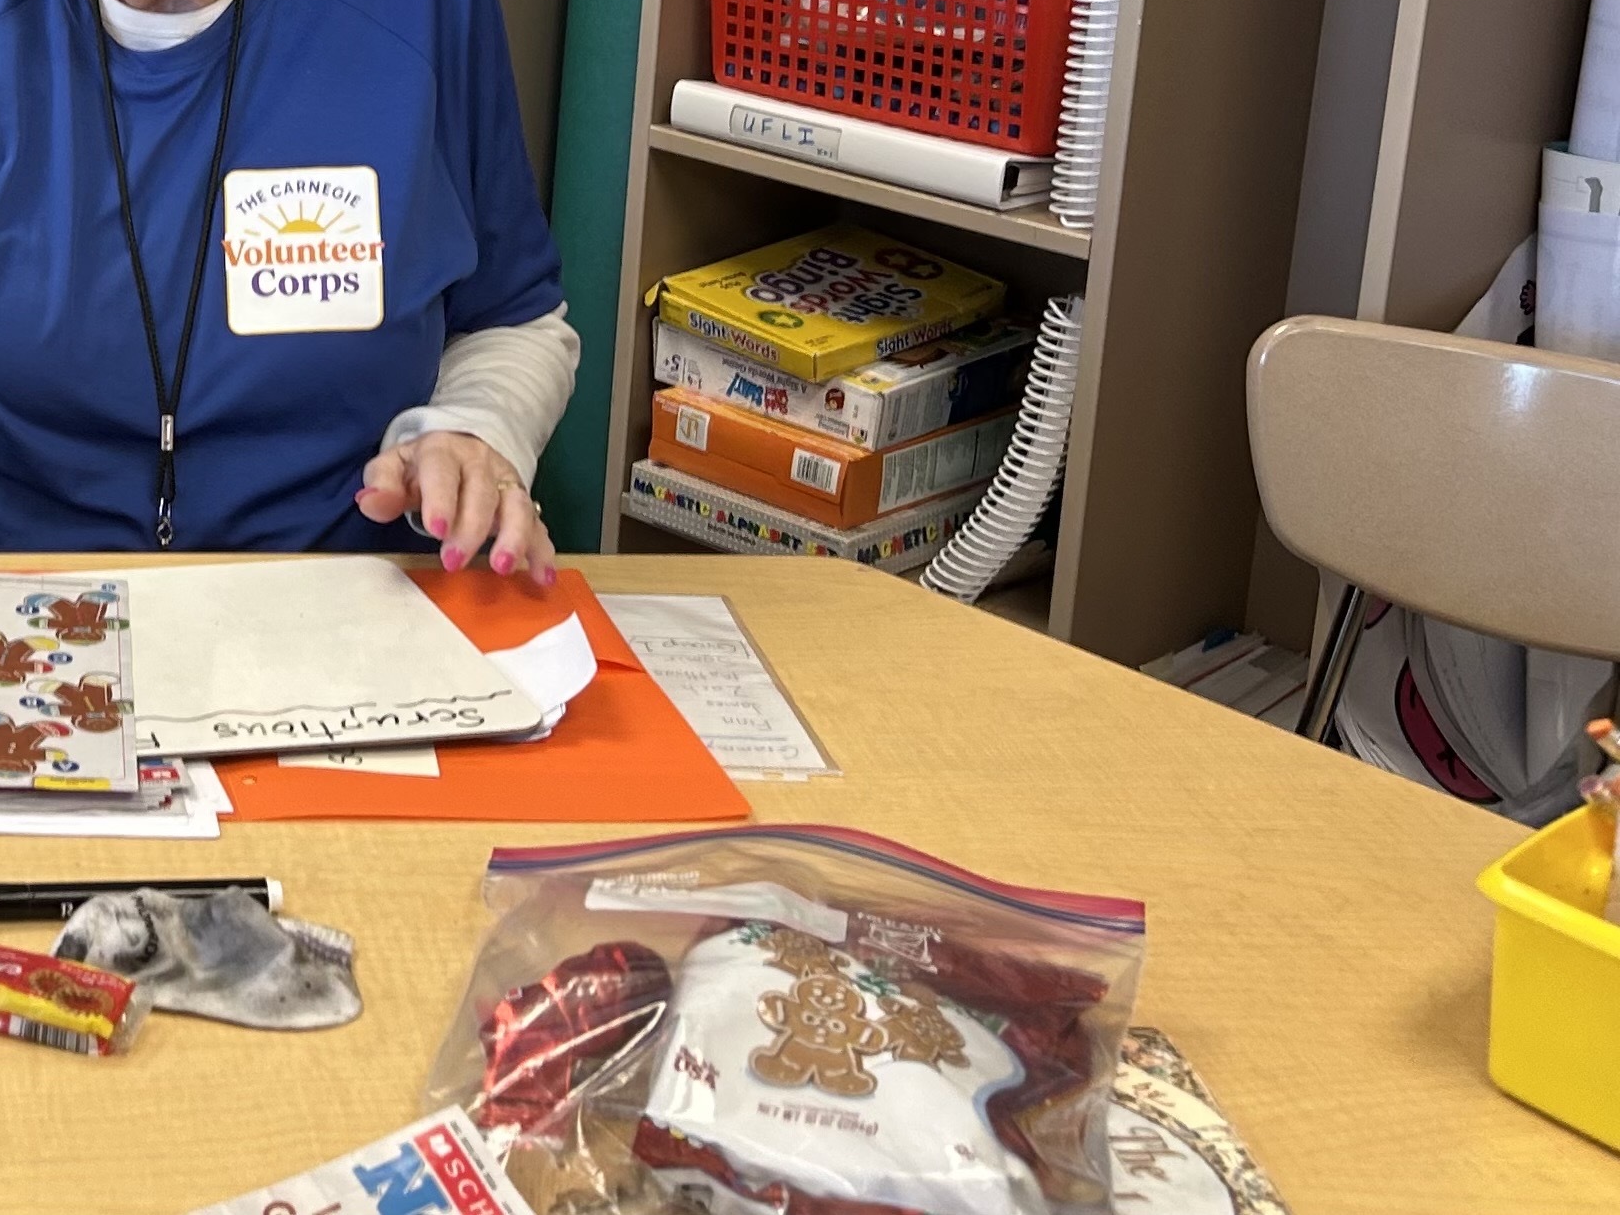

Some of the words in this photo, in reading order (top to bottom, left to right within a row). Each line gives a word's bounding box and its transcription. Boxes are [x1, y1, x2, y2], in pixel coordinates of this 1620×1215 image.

[742, 113, 815, 146] UFLI
[236, 189, 267, 216] THE
[270, 180, 362, 209] CARNEGIE
[221, 238, 385, 267] Volunteer
[251, 268, 360, 302] Corps
[746, 246, 861, 304] Bingo
[789, 267, 895, 315] Words
[829, 282, 924, 325] Sight
[687, 311, 728, 340] Sight
[730, 325, 780, 363] Words
[876, 333, 910, 359] Sight
[633, 476, 711, 517] MAGNETIC
[716, 510, 802, 551] ALPHABET
[857, 521, 937, 564] MAGNETIC
